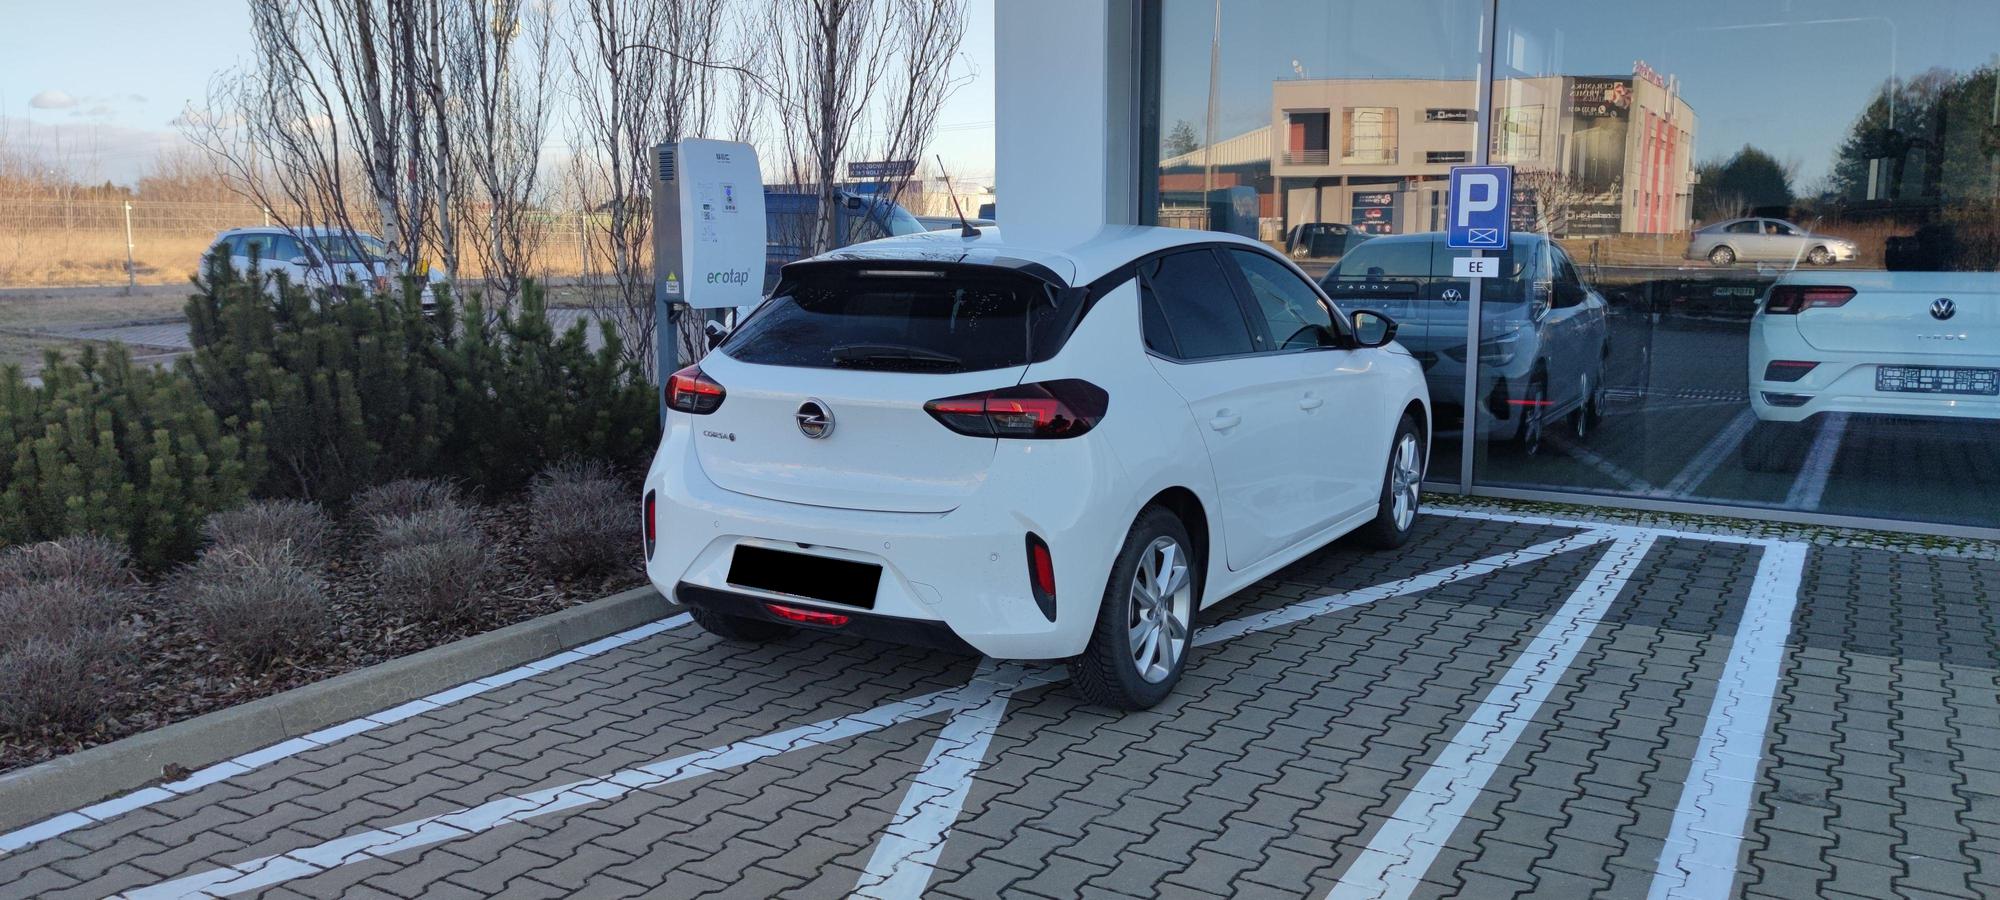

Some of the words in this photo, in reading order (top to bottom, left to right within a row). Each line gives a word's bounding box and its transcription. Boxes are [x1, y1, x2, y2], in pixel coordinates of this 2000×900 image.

[1458, 173, 1498, 226] P
[1469, 261, 1483, 272] EE
[706, 268, 748, 286] ecotap
[703, 430, 729, 440] CORSA
